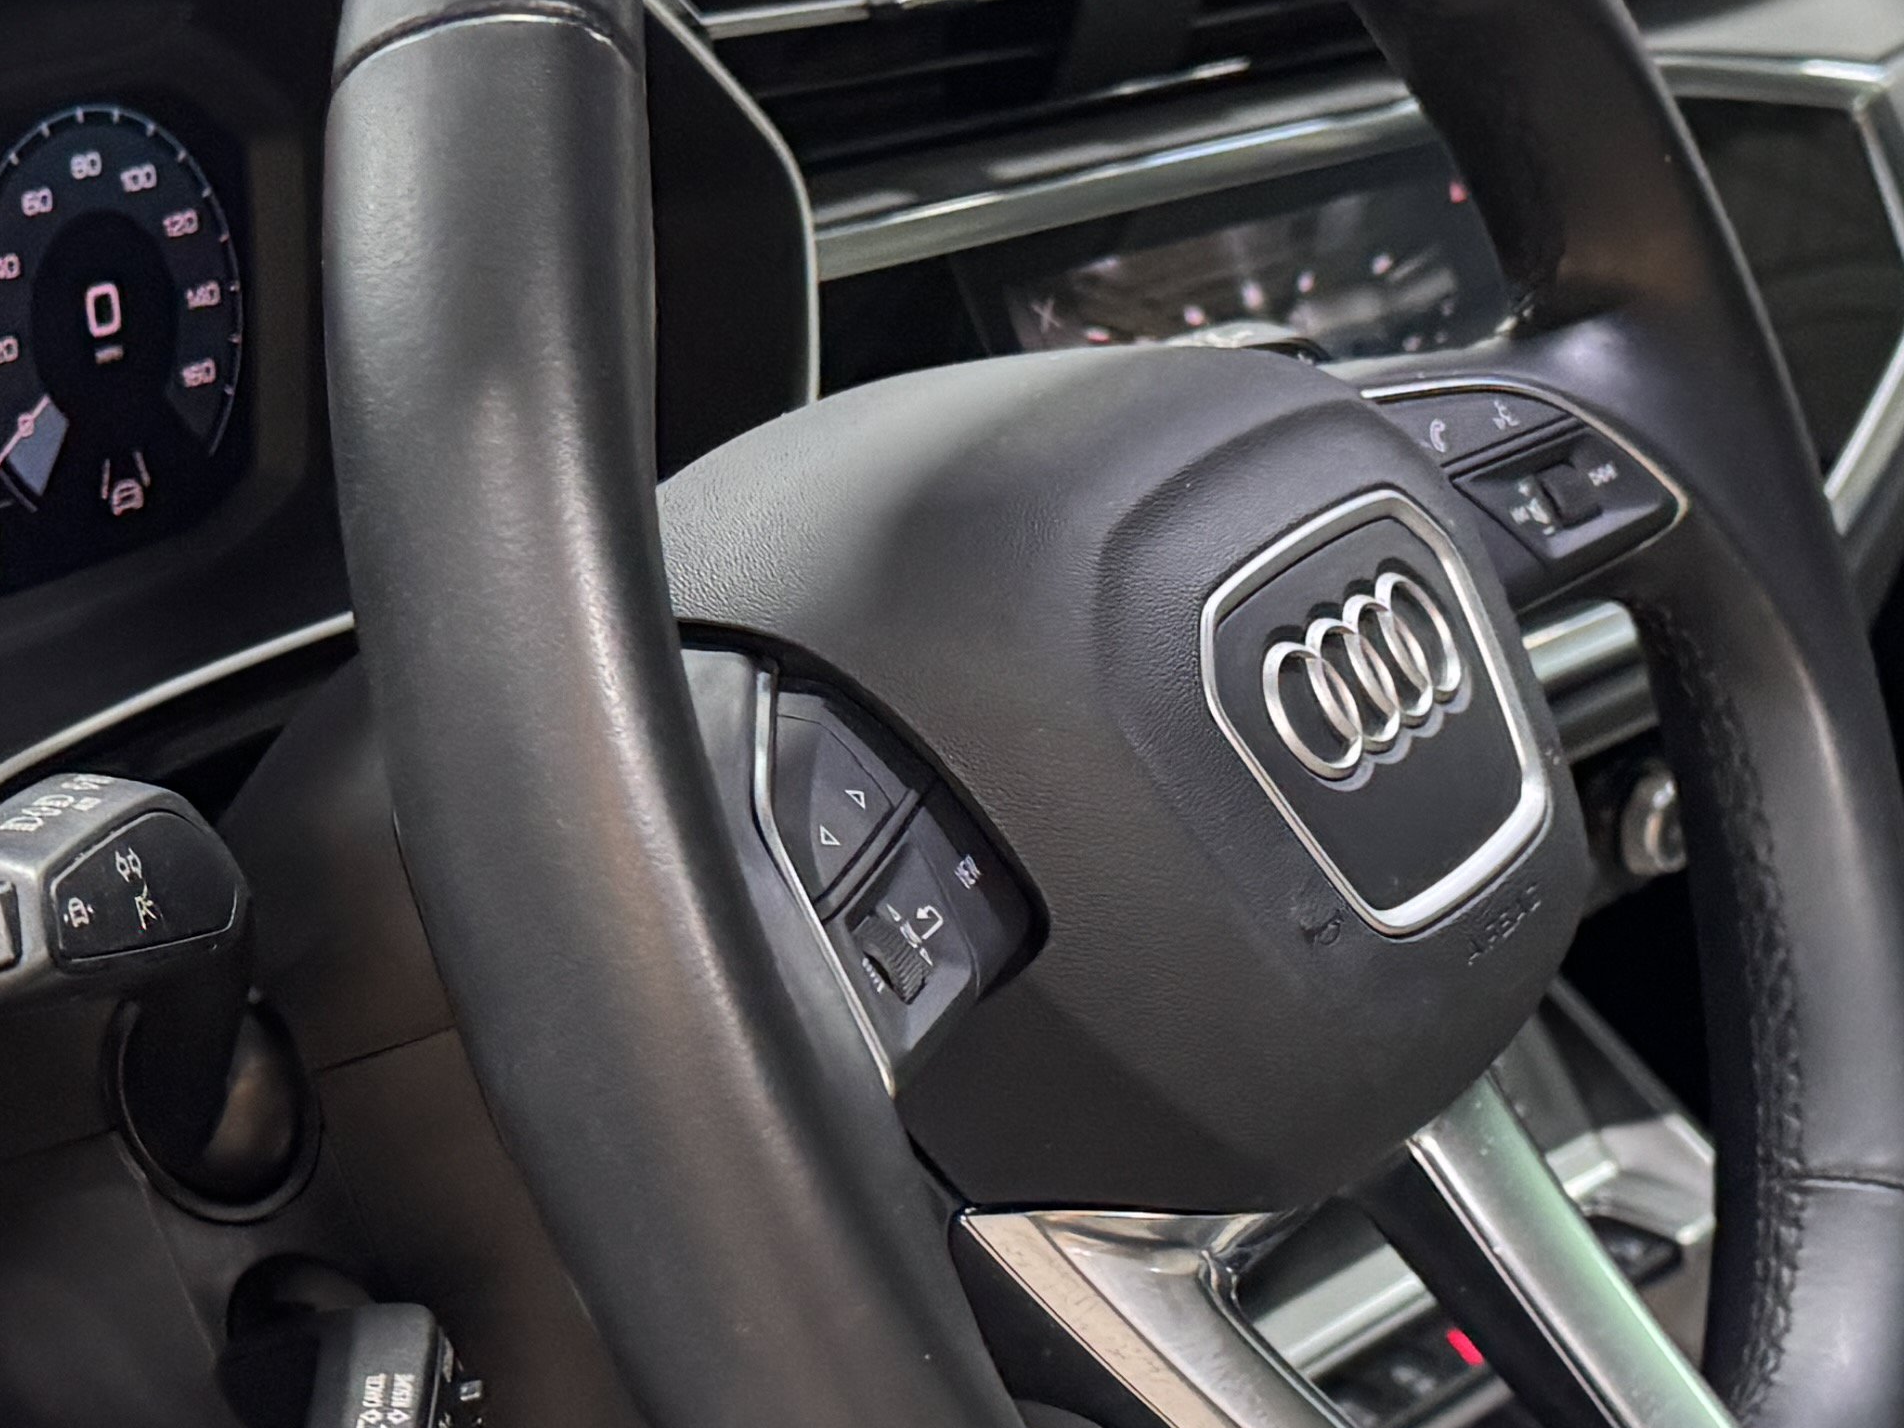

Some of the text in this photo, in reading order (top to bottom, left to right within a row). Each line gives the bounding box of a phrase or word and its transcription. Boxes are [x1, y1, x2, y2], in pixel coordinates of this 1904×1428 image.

[69, 150, 102, 180] 80
[21, 186, 53, 217] 60
[85, 281, 122, 338] 0
